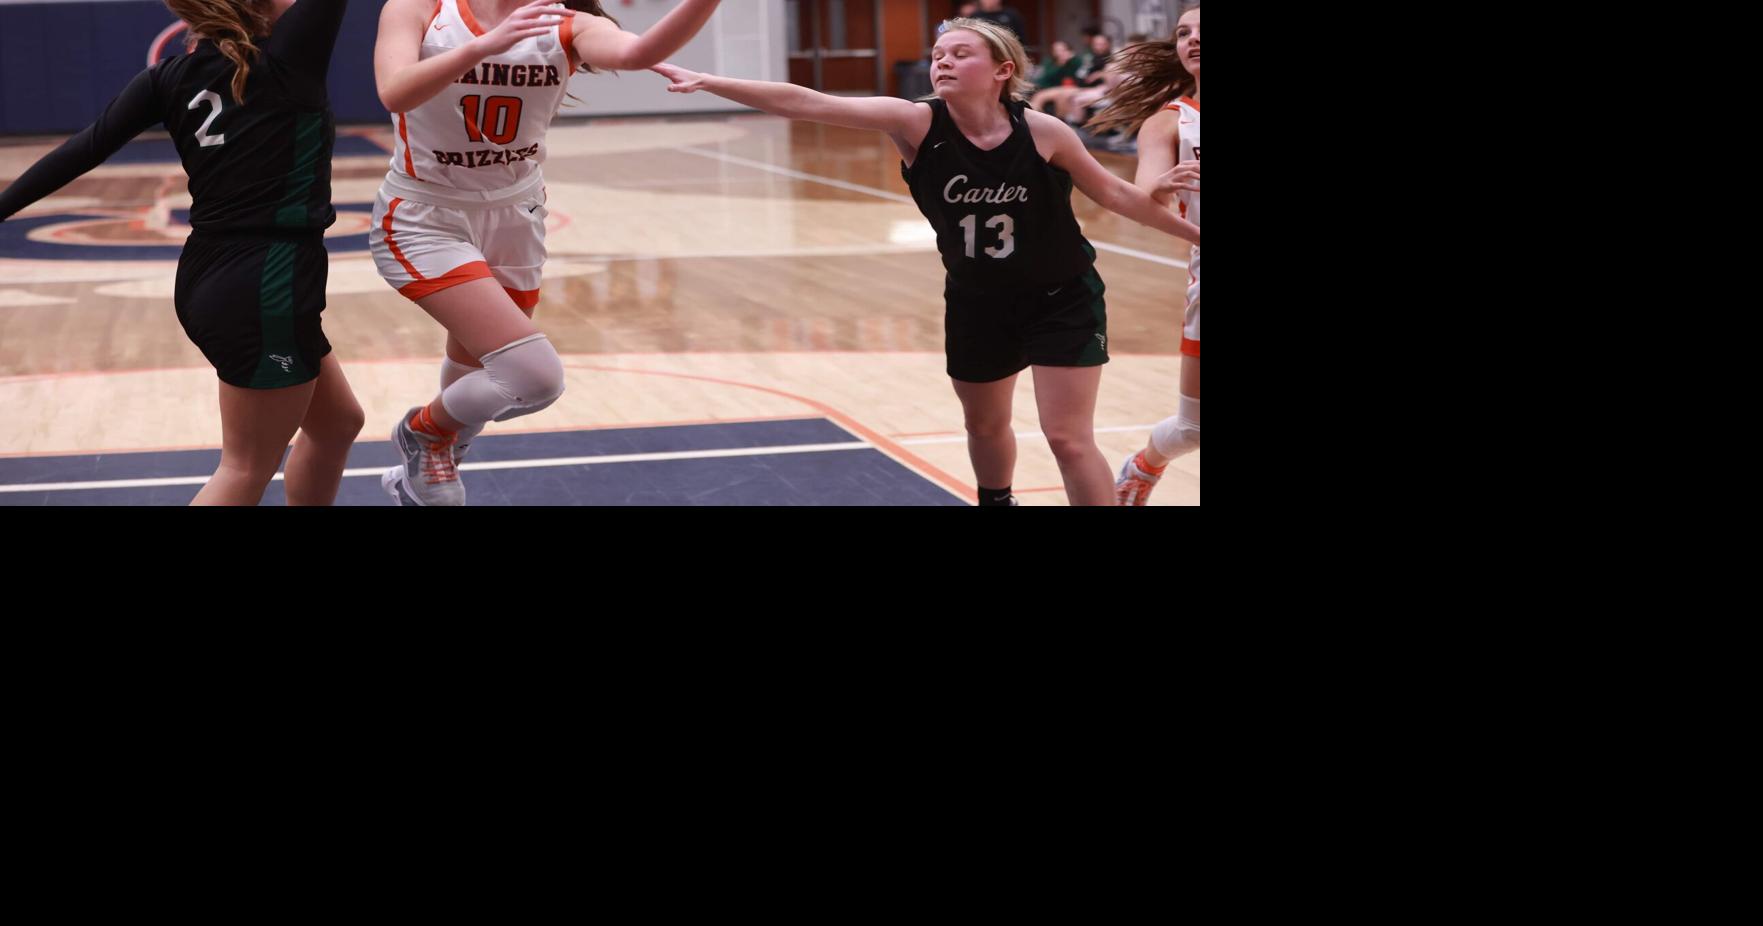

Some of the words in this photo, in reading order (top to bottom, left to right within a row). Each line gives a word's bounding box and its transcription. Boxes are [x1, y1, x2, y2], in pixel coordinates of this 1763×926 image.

[453, 62, 560, 87] AINGER
[188, 88, 225, 147] 2
[460, 94, 523, 145] 10
[943, 174, 1028, 204] Carter
[959, 213, 1015, 259] 13
